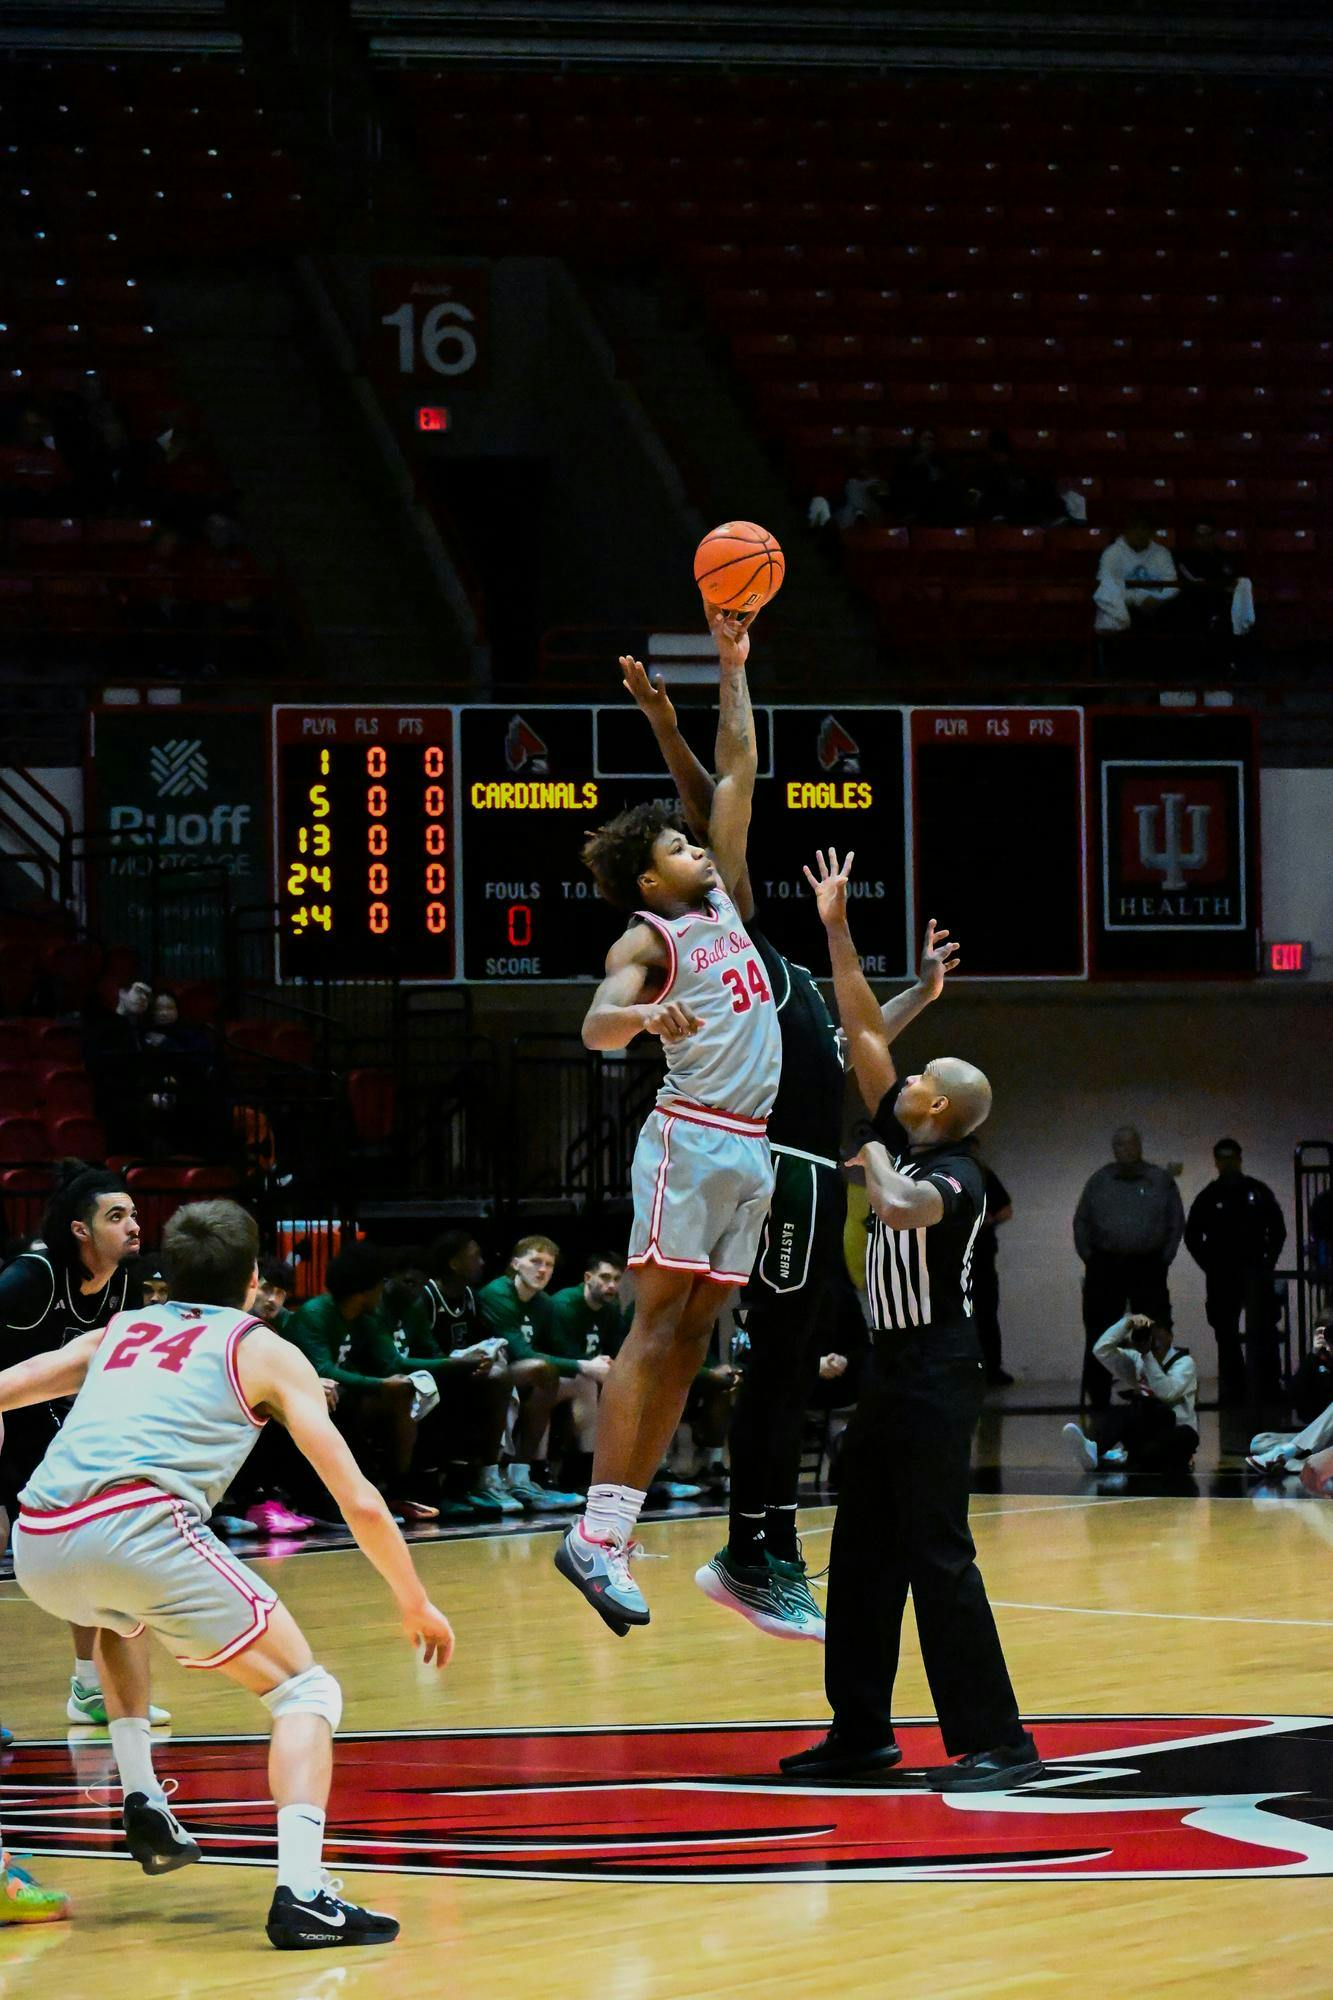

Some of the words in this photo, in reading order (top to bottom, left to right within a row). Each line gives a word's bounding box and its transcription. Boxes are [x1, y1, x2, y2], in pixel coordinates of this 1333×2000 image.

[380, 301, 478, 376] 16
[302, 716, 337, 736] PLYR
[354, 716, 380, 736] FLS
[398, 716, 424, 736] PTS
[934, 717, 968, 736] PLYR
[986, 717, 1010, 736] FLS
[1028, 717, 1054, 736] PTS
[320, 748, 331, 777] 1
[365, 746, 388, 778] 0
[423, 746, 445, 778] 0
[308, 784, 331, 818] 5
[366, 785, 388, 817] 0
[424, 785, 446, 817] 0
[470, 781, 599, 810] CARDINALS
[786, 782, 874, 810] EAGLES
[110, 804, 252, 846] Ruoff
[298, 823, 332, 857] 13
[367, 824, 389, 856] 0
[425, 824, 446, 856] 0
[287, 862, 333, 897] 24
[367, 862, 390, 896] 0
[425, 862, 447, 896] 0
[484, 881, 541, 900] FOULS
[368, 901, 390, 935] 0
[426, 901, 448, 935] 0
[1119, 896, 1232, 917] HEALTH
[505, 902, 534, 948] 0
[484, 957, 543, 975] SCORE
[690, 936, 728, 974] Ball
[721, 958, 771, 1014] 34
[779, 1222, 795, 1279] EASTERN
[103, 1322, 208, 1374] 24
